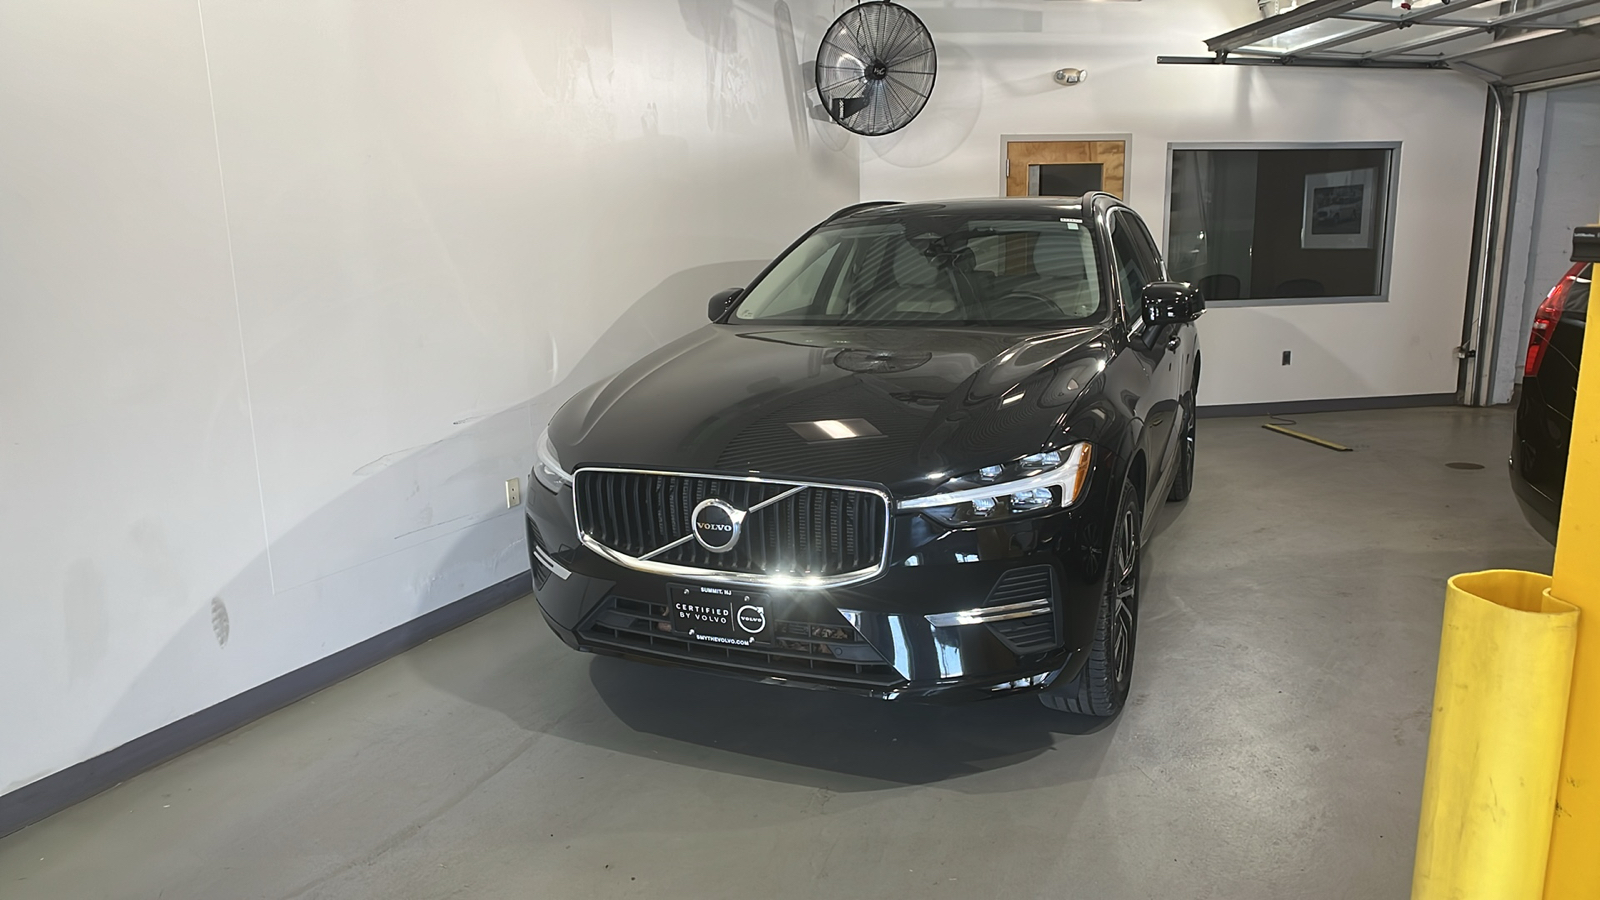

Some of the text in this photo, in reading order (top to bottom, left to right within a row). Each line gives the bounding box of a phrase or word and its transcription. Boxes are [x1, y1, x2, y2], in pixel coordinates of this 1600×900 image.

[697, 522, 732, 531] VOLVO
[675, 603, 729, 616] CERTIFIED
[695, 614, 727, 624] VOLVO
[696, 634, 749, 646] SMYTHEVOLVO.COM
